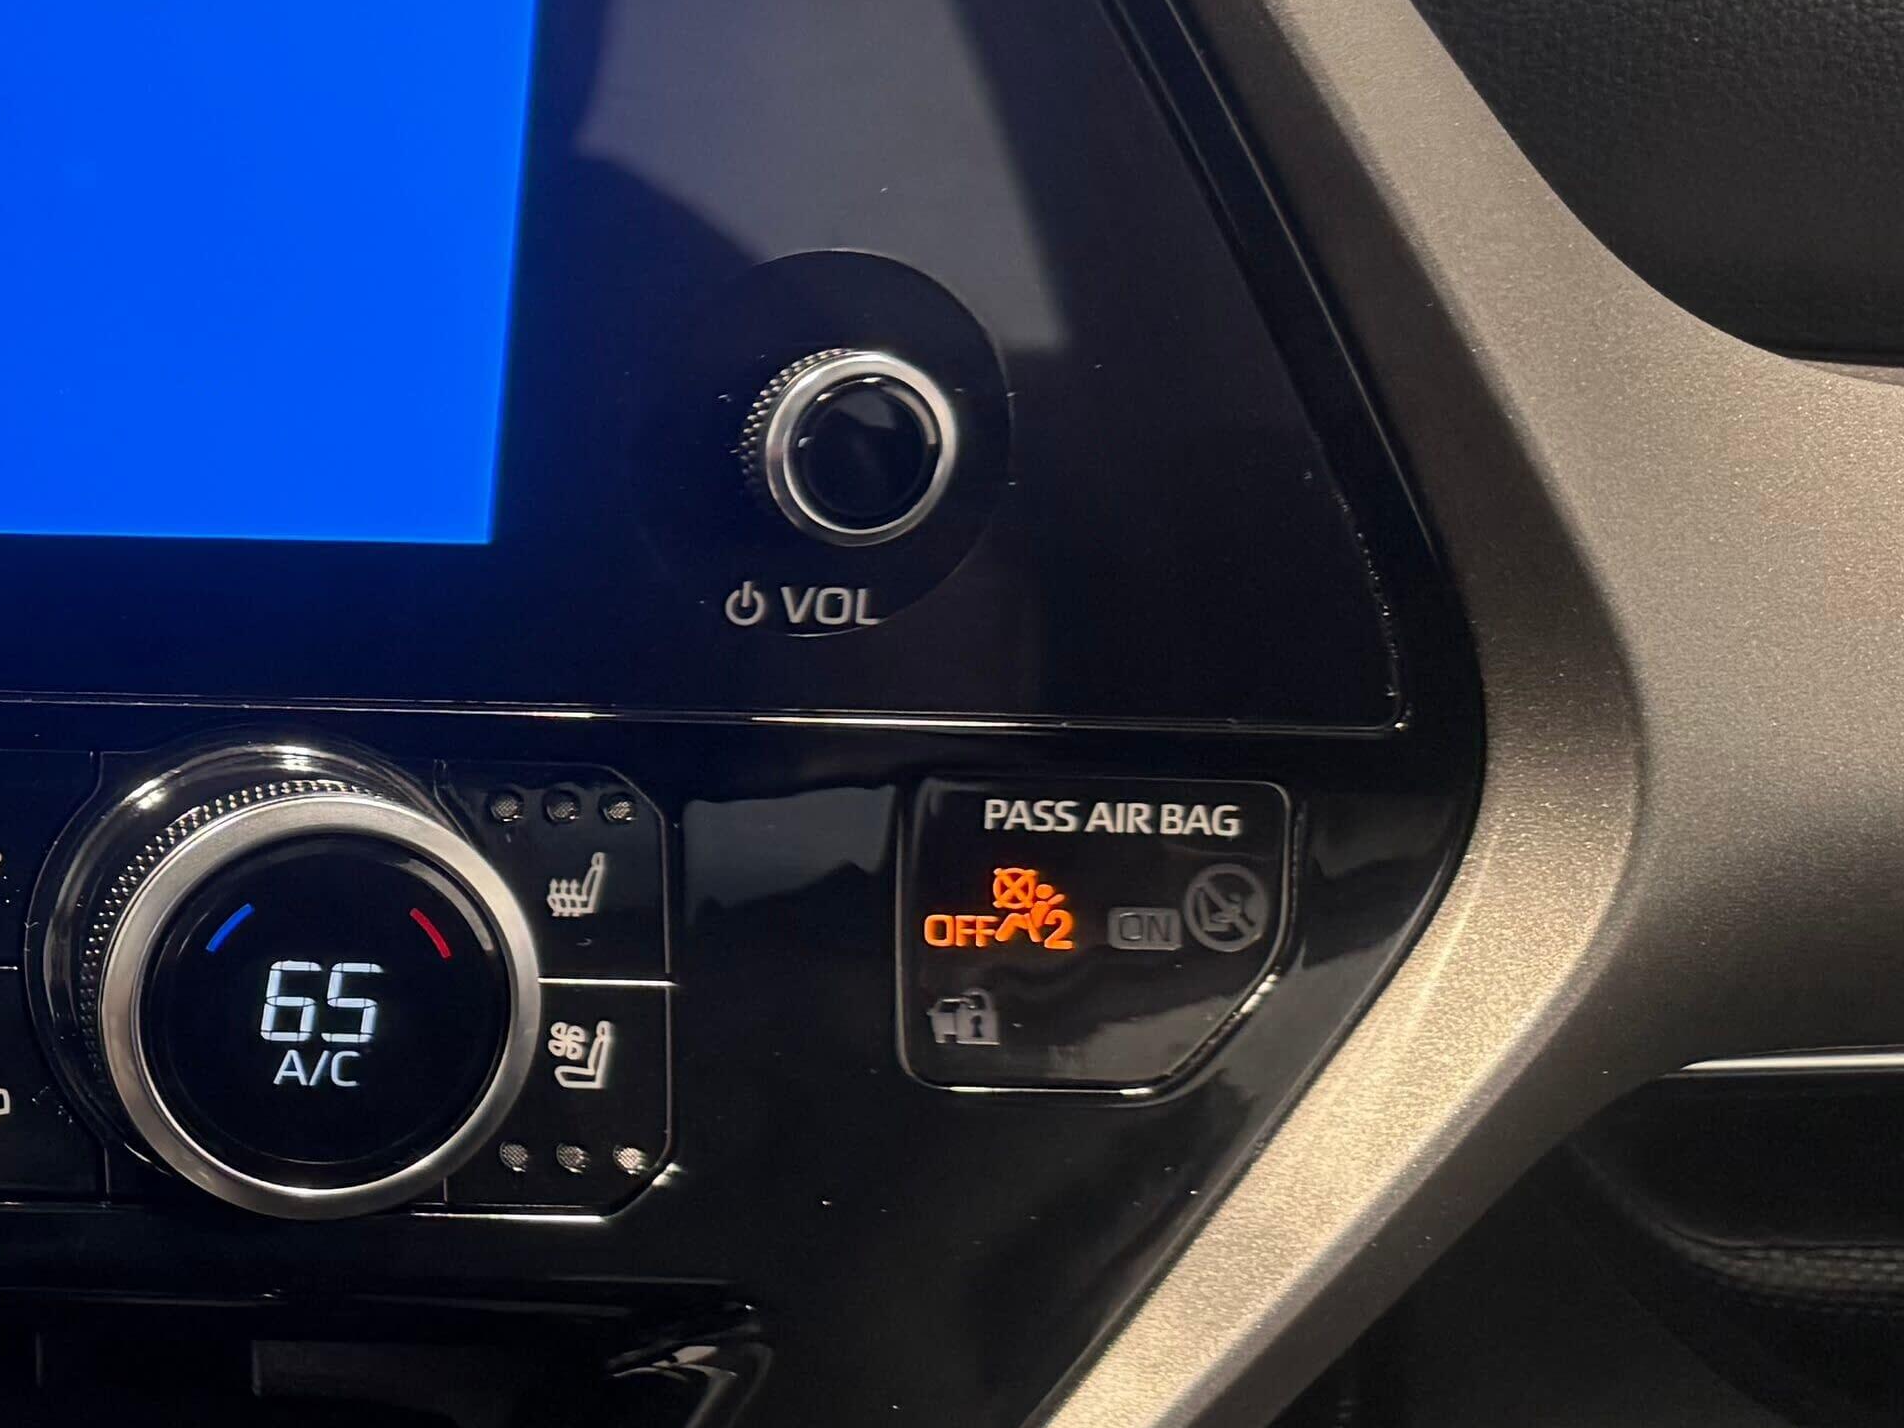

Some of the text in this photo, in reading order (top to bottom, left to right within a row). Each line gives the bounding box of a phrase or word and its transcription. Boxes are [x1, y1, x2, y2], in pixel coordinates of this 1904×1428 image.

[781, 586, 884, 625] VOL
[984, 799, 1242, 836] PASS AIR BAG
[924, 914, 999, 947] OFF
[1118, 912, 1171, 943] ON
[260, 960, 384, 1043] 65
[274, 1050, 360, 1086] A/C
